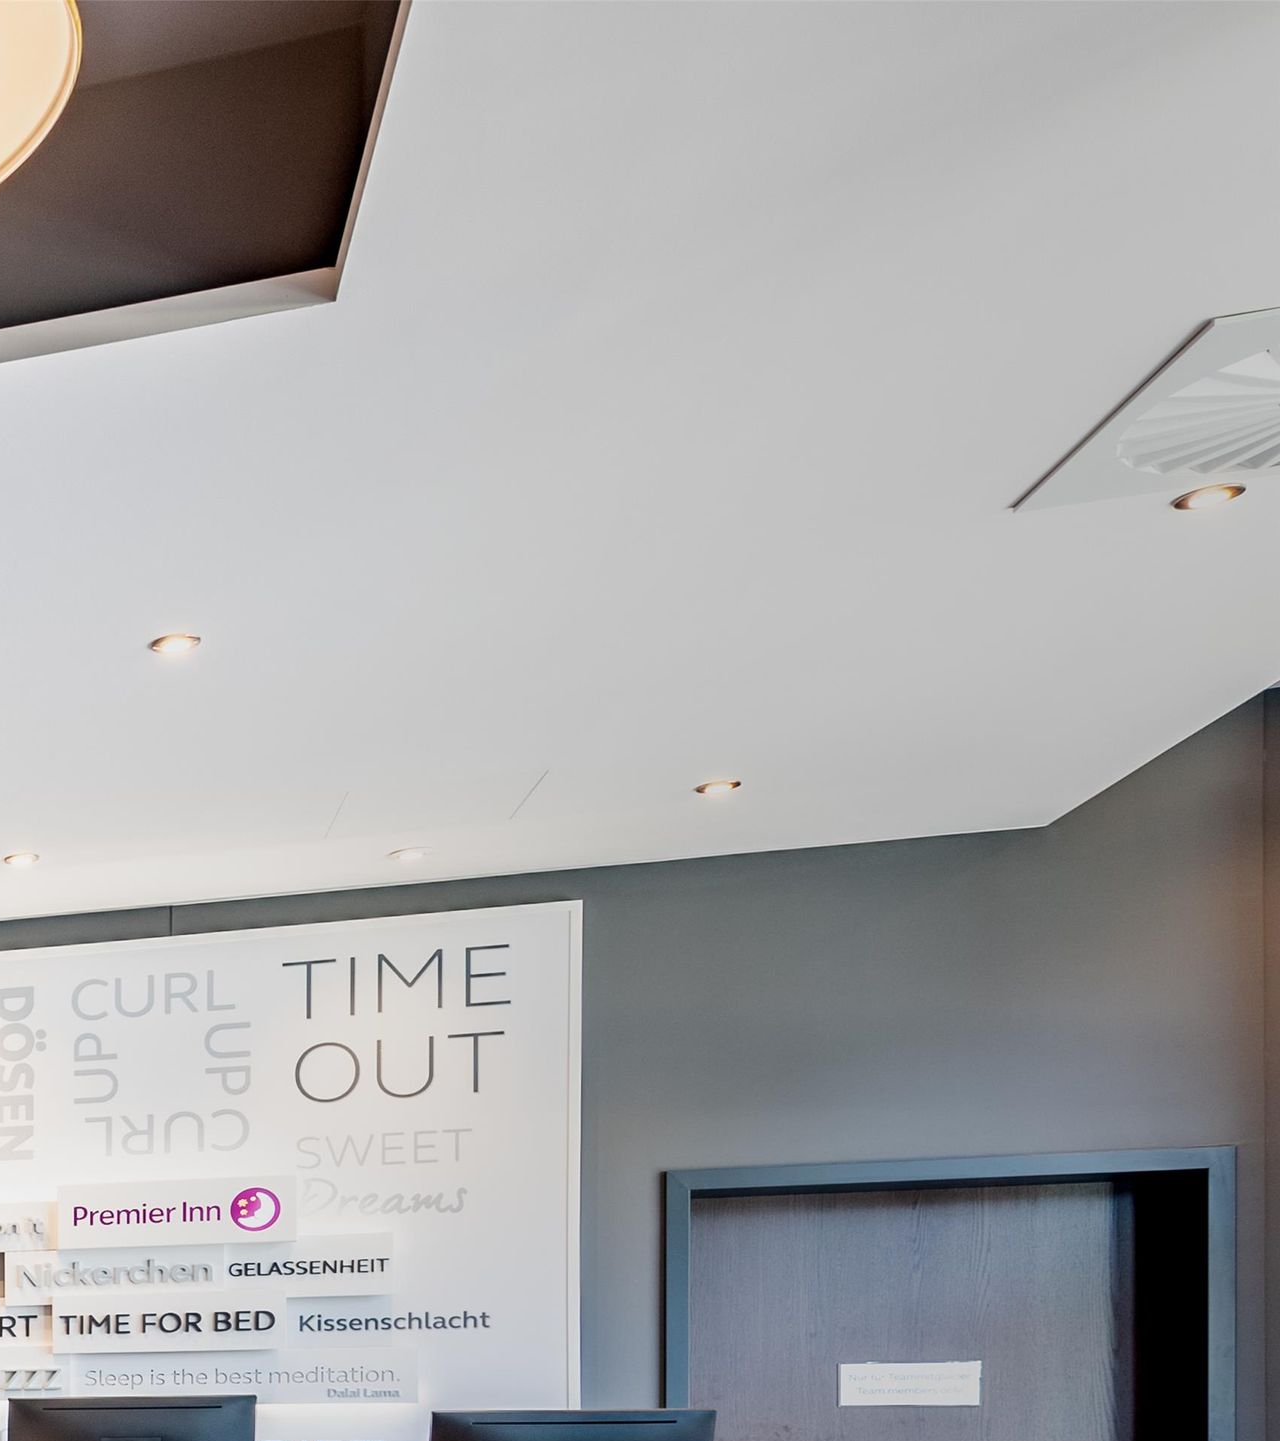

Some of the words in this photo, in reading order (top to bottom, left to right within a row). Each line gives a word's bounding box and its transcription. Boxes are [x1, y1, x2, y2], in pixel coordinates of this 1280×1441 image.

[71, 970, 236, 1021] CURL
[282, 944, 511, 1019] TIME
[74, 1033, 118, 1104] UP
[204, 1022, 251, 1095] UP
[295, 1031, 505, 1103] OUT
[85, 1109, 250, 1156] CURL
[296, 1128, 472, 1169] SWEET
[73, 1203, 176, 1226] Premier
[182, 1202, 220, 1222] Inn
[298, 1178, 468, 1216] Dreams
[16, 1258, 214, 1288] Nickerchen
[228, 1257, 389, 1277] GELASSENHEIT
[59, 1314, 131, 1336] TIME
[142, 1312, 202, 1333] FOR
[214, 1310, 276, 1332] BED
[299, 1310, 491, 1332] Kissenschlacht
[85, 1369, 143, 1390] Sleep
[150, 1369, 166, 1386] is
[173, 1368, 208, 1385] the
[214, 1367, 263, 1384] best
[269, 1366, 400, 1384] meditation.
[327, 1387, 360, 1398] Dalai
[363, 1387, 400, 1398] Lama
